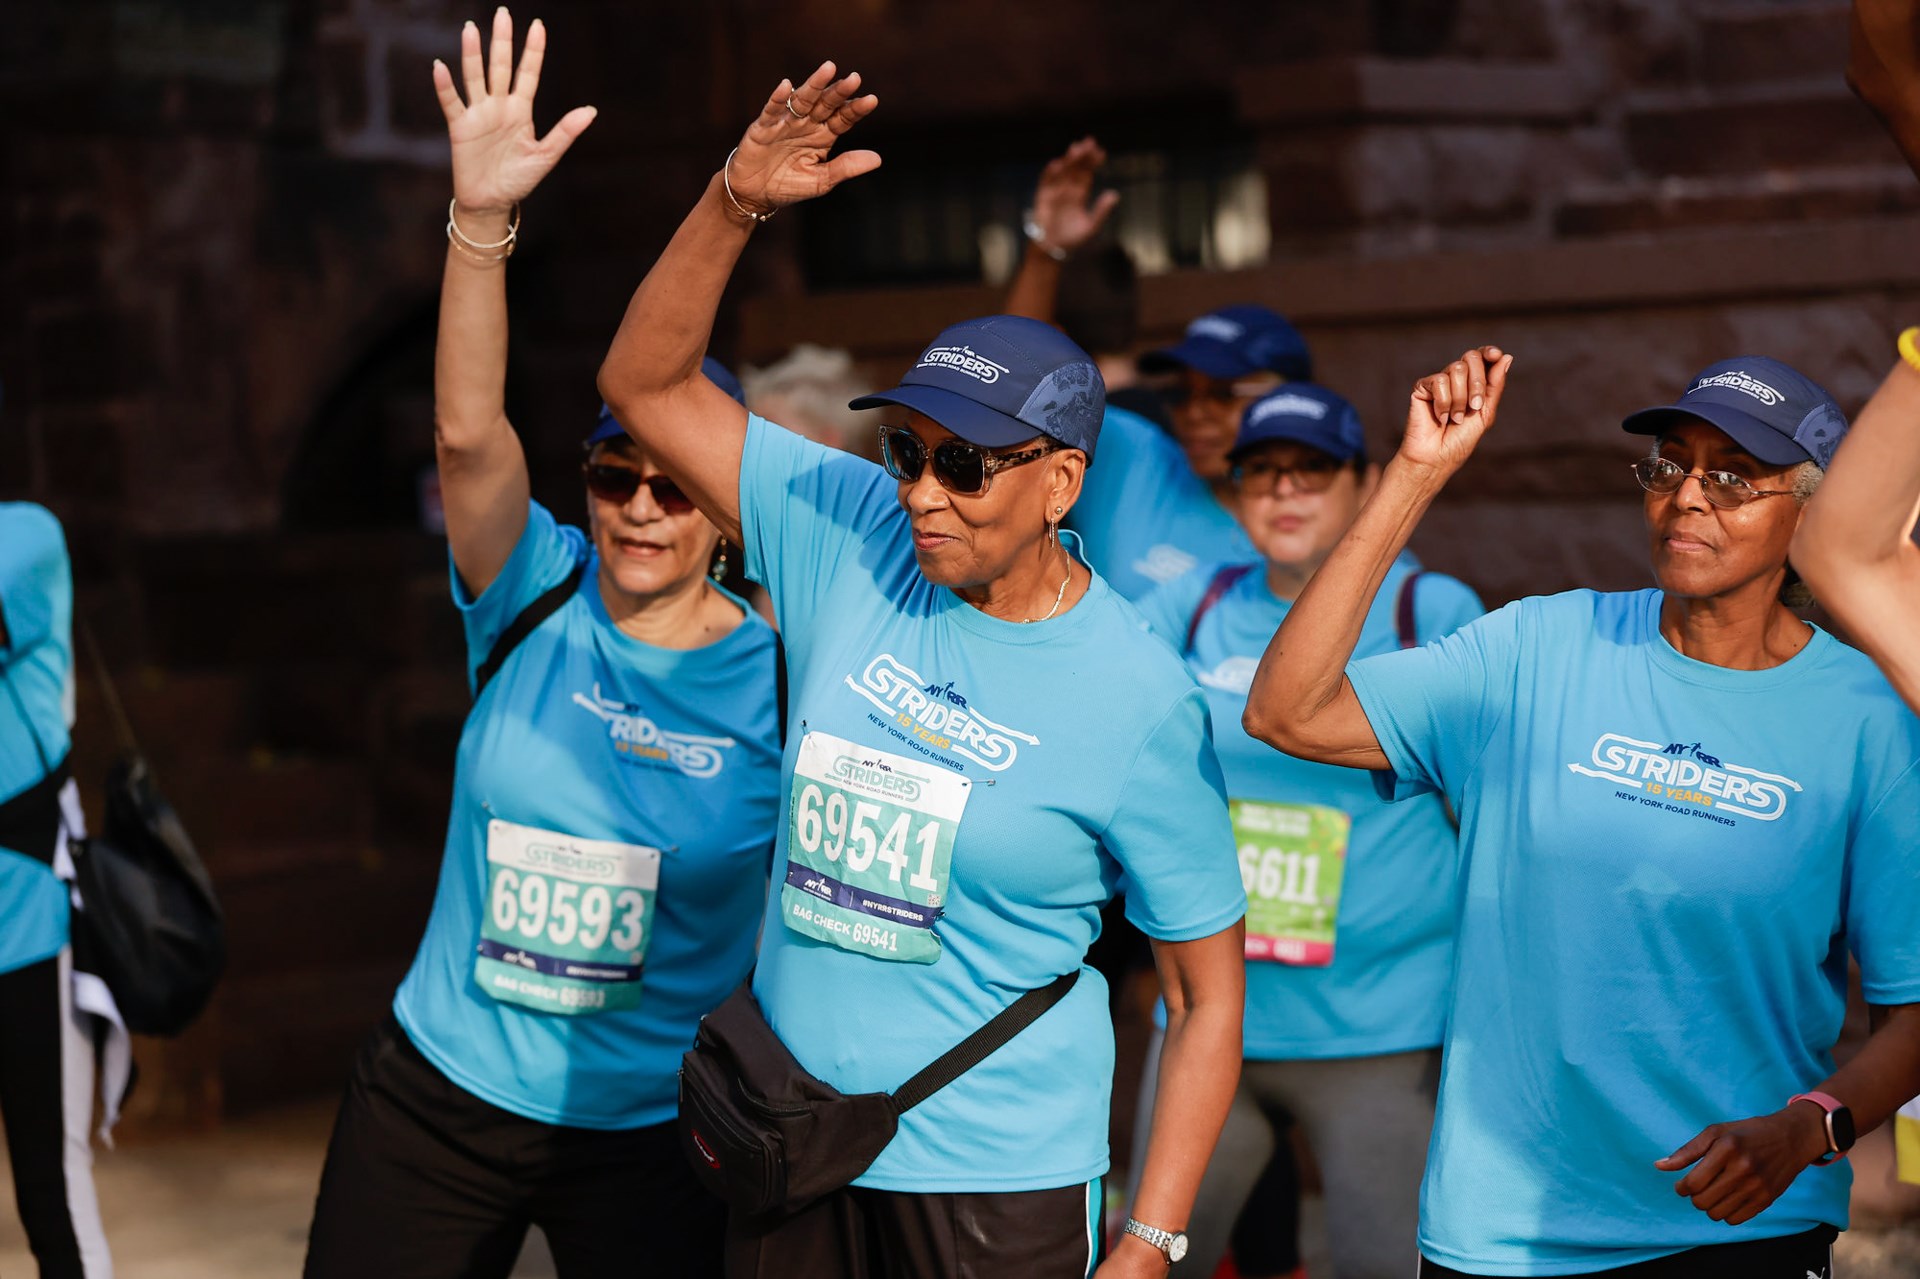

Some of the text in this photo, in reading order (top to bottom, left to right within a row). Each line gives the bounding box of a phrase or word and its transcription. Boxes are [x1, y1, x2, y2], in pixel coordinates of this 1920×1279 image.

[927, 352, 992, 377] STRIDERS
[1702, 375, 1770, 400] STRIDERS
[868, 667, 1003, 759] STRIDERS
[897, 712, 951, 750] 15 YEARS
[868, 713, 965, 771] NEW YORK ROAD RUNNERS
[838, 762, 915, 795] STRIDERS
[881, 790, 904, 800] RUNNERS
[1605, 746, 1771, 808] STRIDERS
[1646, 782, 1712, 807] 15 YEARS
[1615, 791, 1736, 827] NEW YORK ROAD RUNNERS
[798, 784, 941, 892] 69541
[492, 869, 645, 951] 69593
[793, 904, 898, 952] BAG CHECK 69541
[862, 899, 924, 922] #NYRRSTRIDERS
